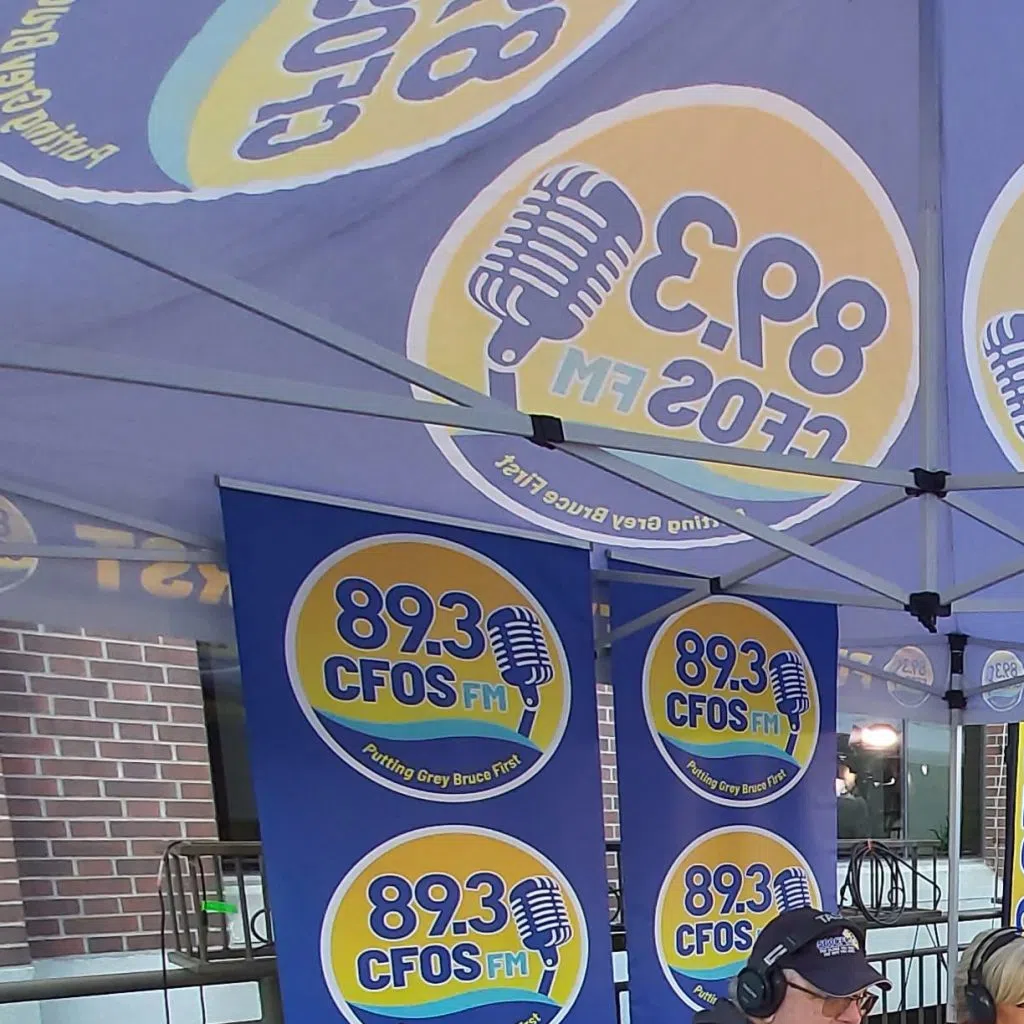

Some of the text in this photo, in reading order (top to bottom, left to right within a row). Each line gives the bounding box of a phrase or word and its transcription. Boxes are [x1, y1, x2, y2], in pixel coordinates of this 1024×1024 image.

[334, 576, 486, 661] 89.3
[323, 655, 508, 712] CFOS FM
[675, 629, 768, 695] 89.3
[665, 691, 781, 736] CFOS FM
[361, 744, 522, 789] Putting Grey Bruce First
[687, 760, 787, 797] Putting Grey Bruce First
[366, 872, 509, 941] 89.3
[684, 863, 772, 917] 89.3
[675, 919, 754, 957] CFOS
[355, 942, 529, 992] CFOS FM
